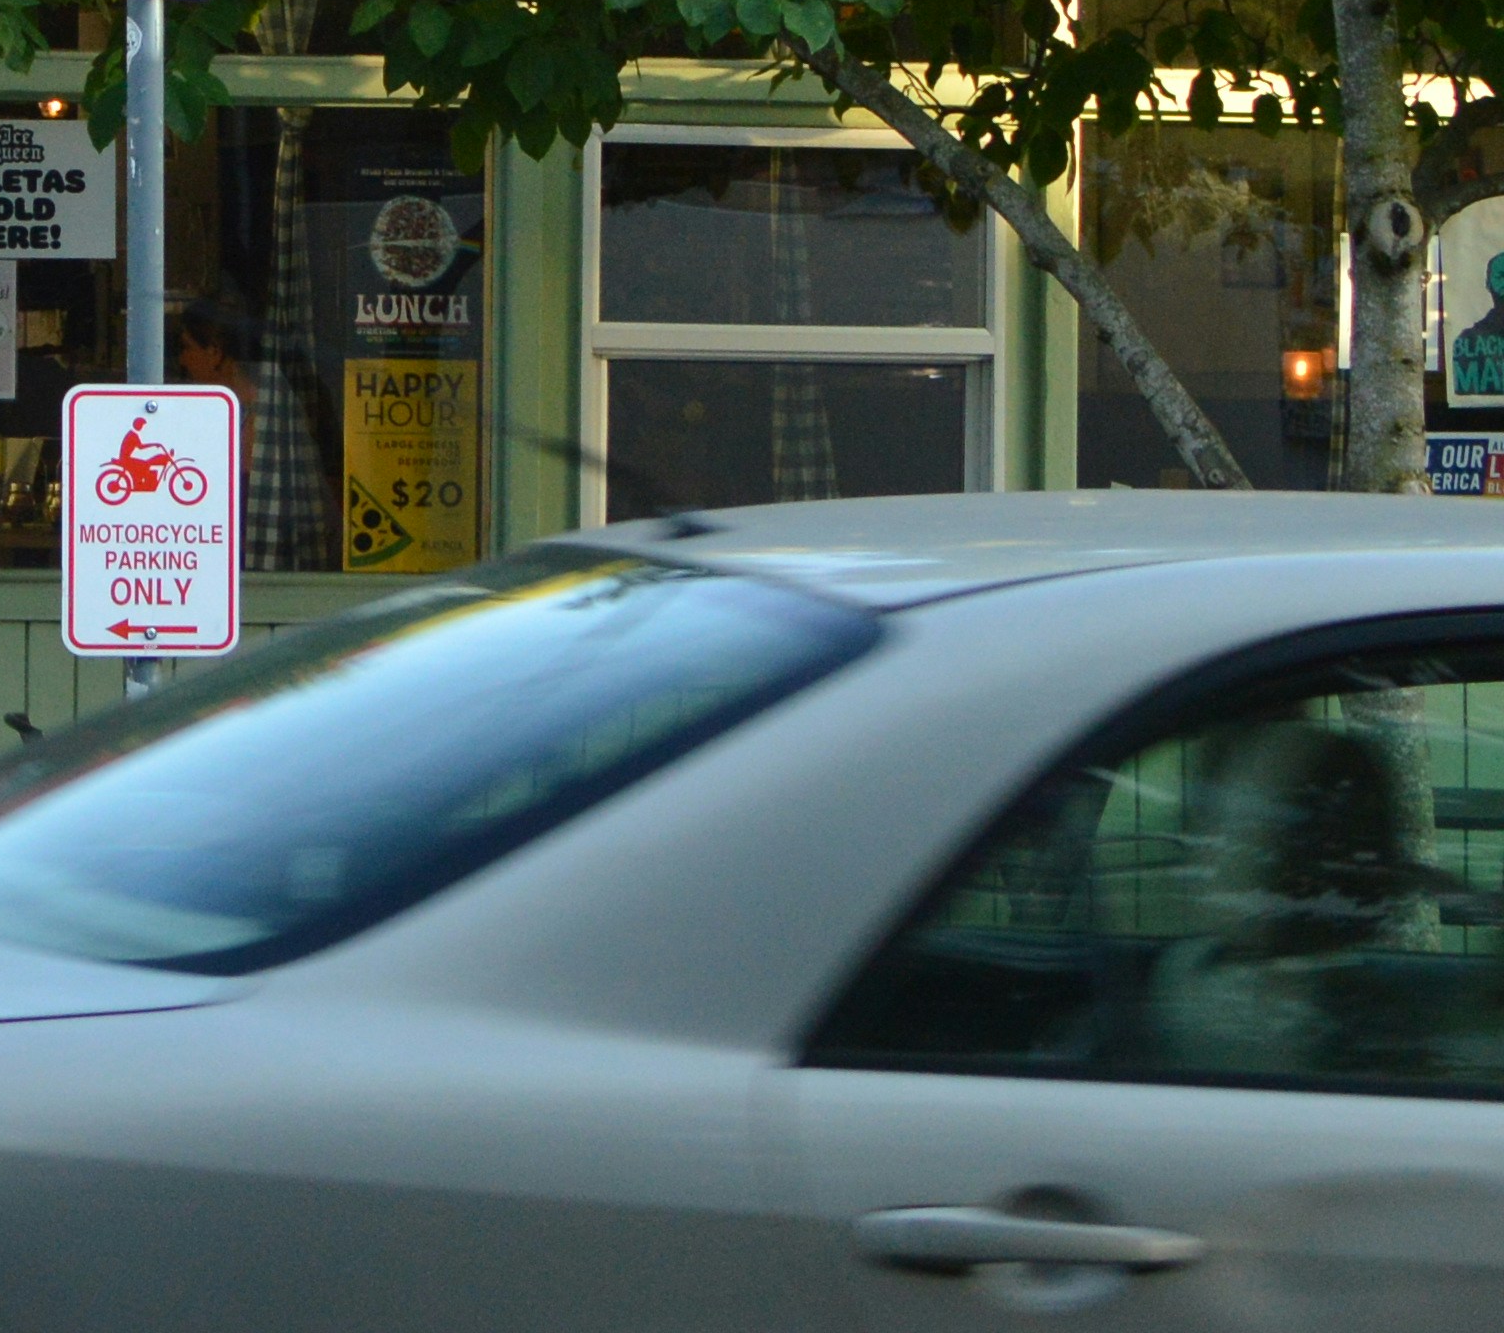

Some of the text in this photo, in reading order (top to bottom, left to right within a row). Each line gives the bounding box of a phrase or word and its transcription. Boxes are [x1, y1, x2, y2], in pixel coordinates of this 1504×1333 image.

[354, 293, 471, 325] LUNCH
[355, 371, 465, 399] HAPPY
[363, 399, 458, 428] HOUR
[376, 440, 414, 450] LARGE
[1441, 444, 1485, 469] OUR
[391, 477, 464, 511] $20
[1432, 472, 1481, 491] ERICA
[78, 523, 224, 546] MOTORCYCLE
[105, 550, 199, 572] PARKING
[109, 577, 192, 608] ONLY
